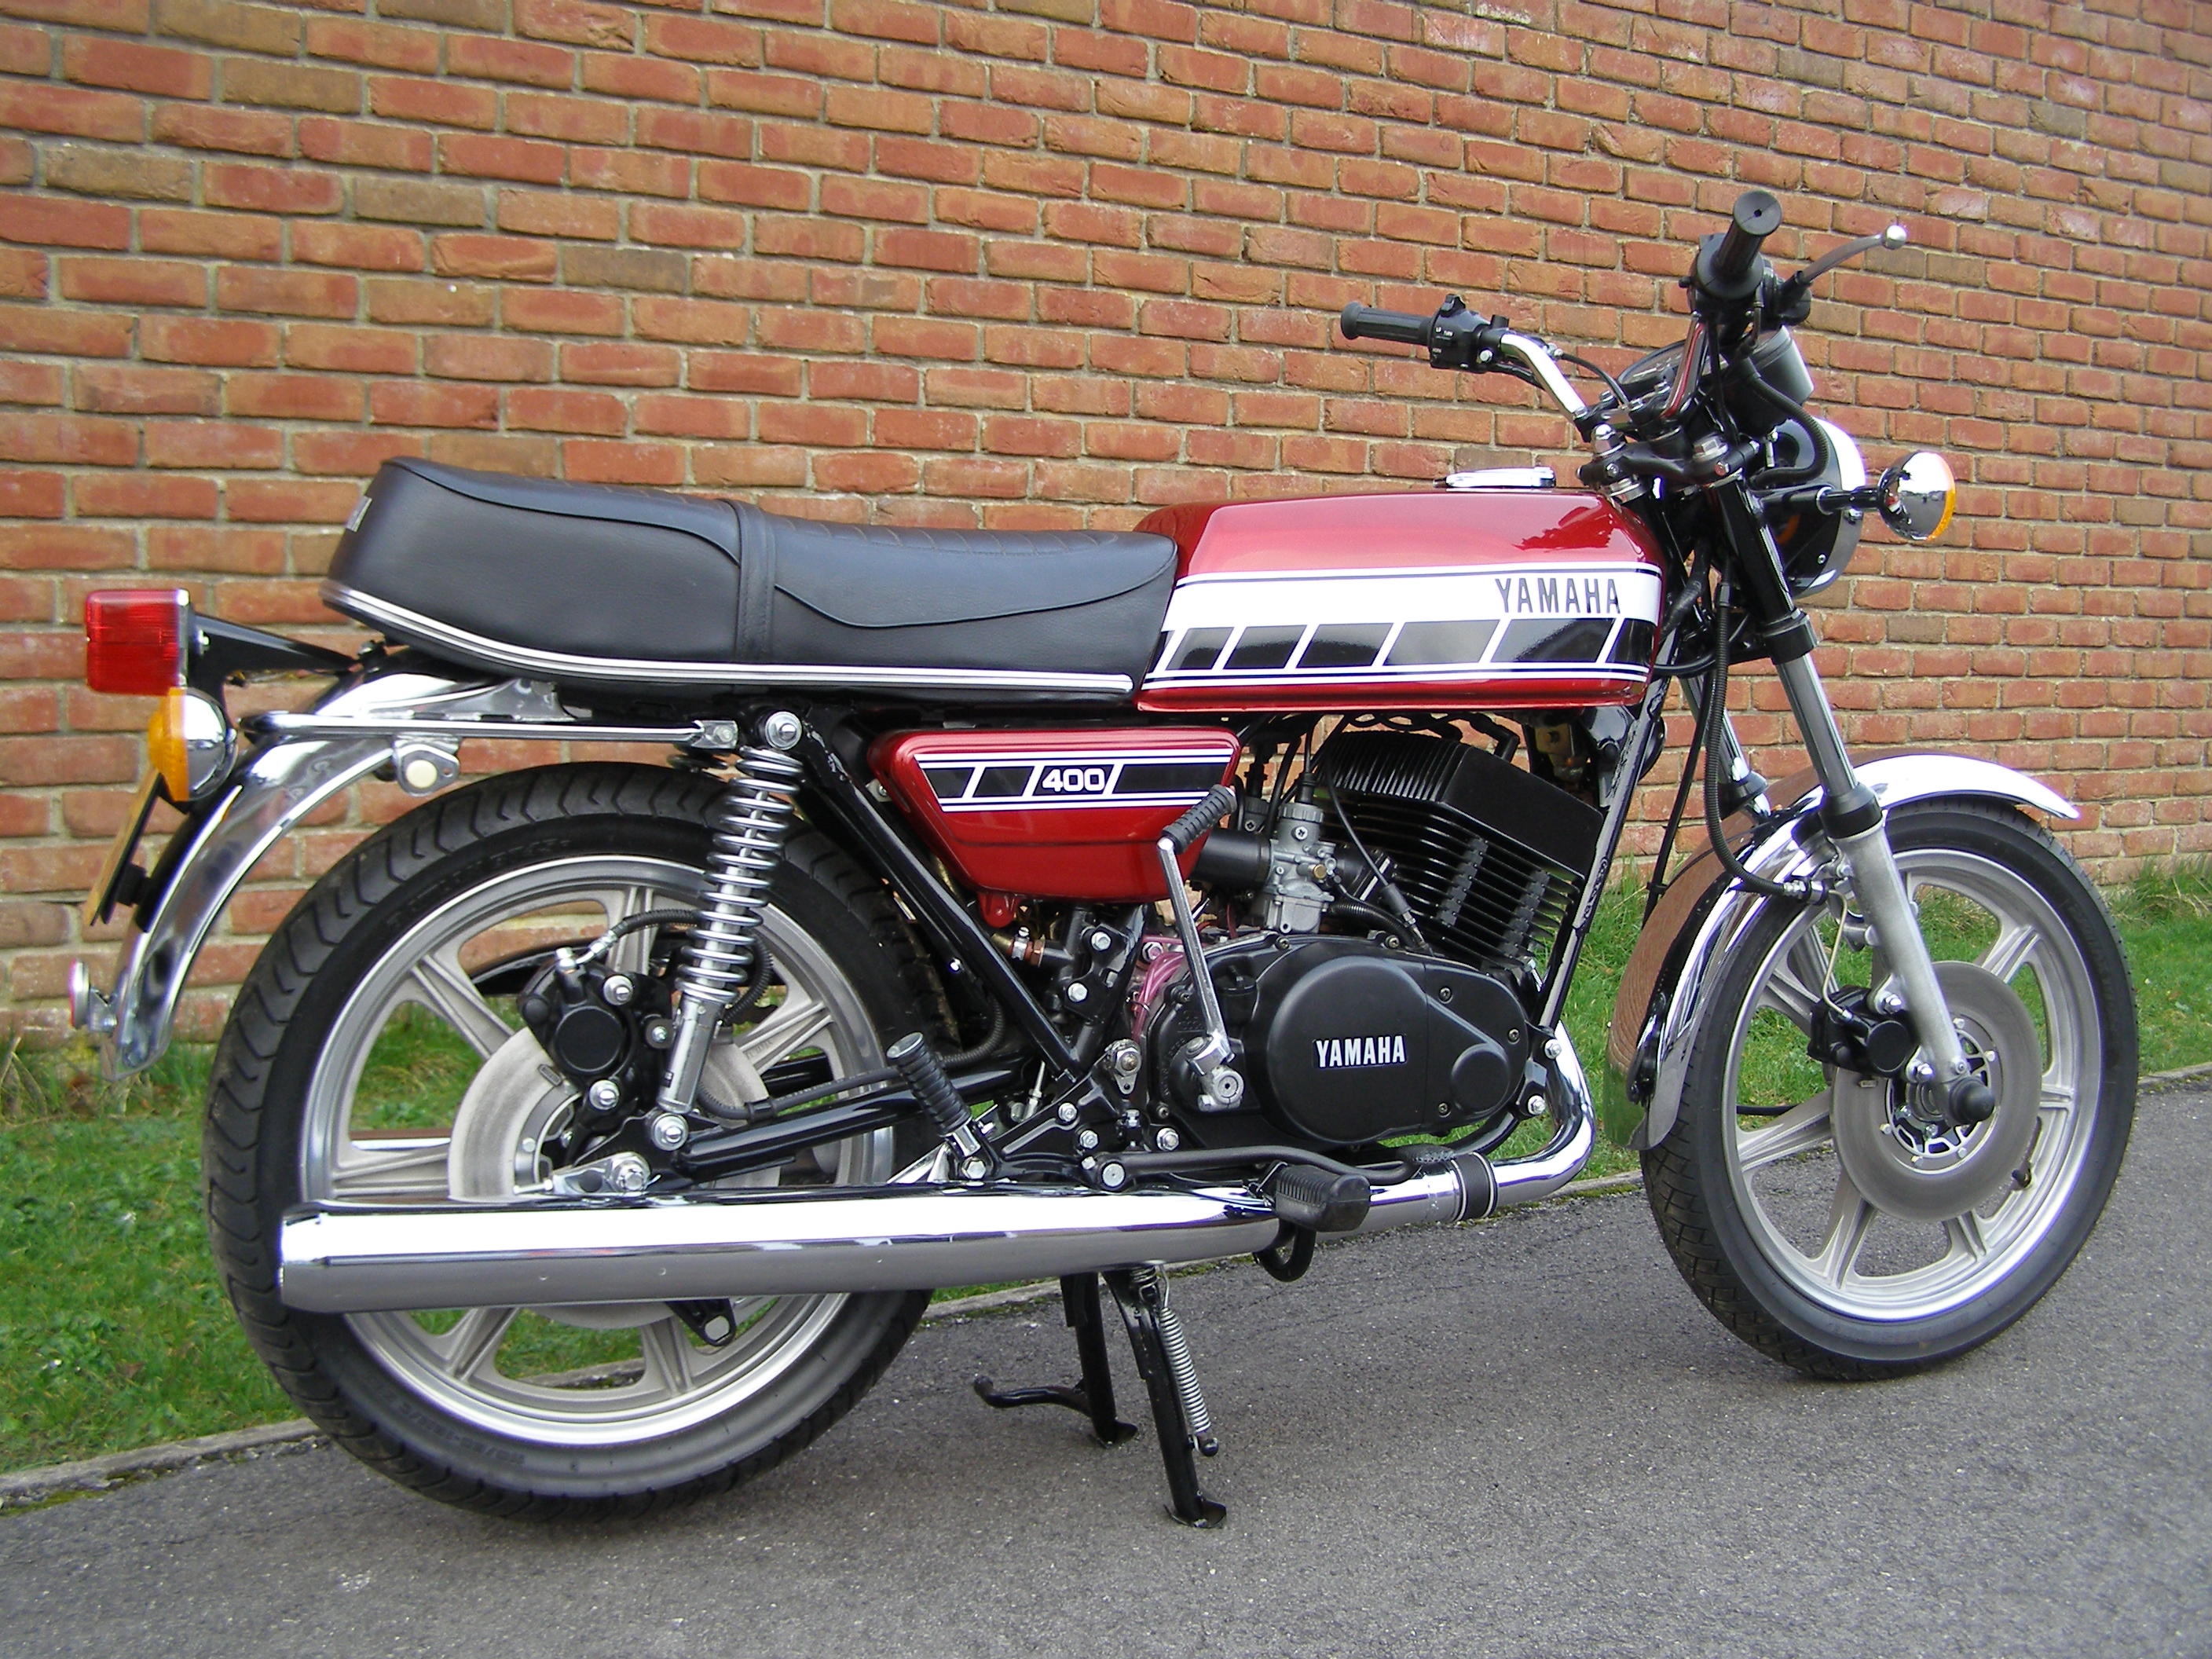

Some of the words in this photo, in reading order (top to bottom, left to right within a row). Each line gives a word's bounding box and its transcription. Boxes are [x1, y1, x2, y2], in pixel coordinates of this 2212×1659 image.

[1495, 577, 1621, 613] YAMAHA
[1042, 767, 1105, 793] 400
[1316, 1035, 1405, 1068] YAMAHA
